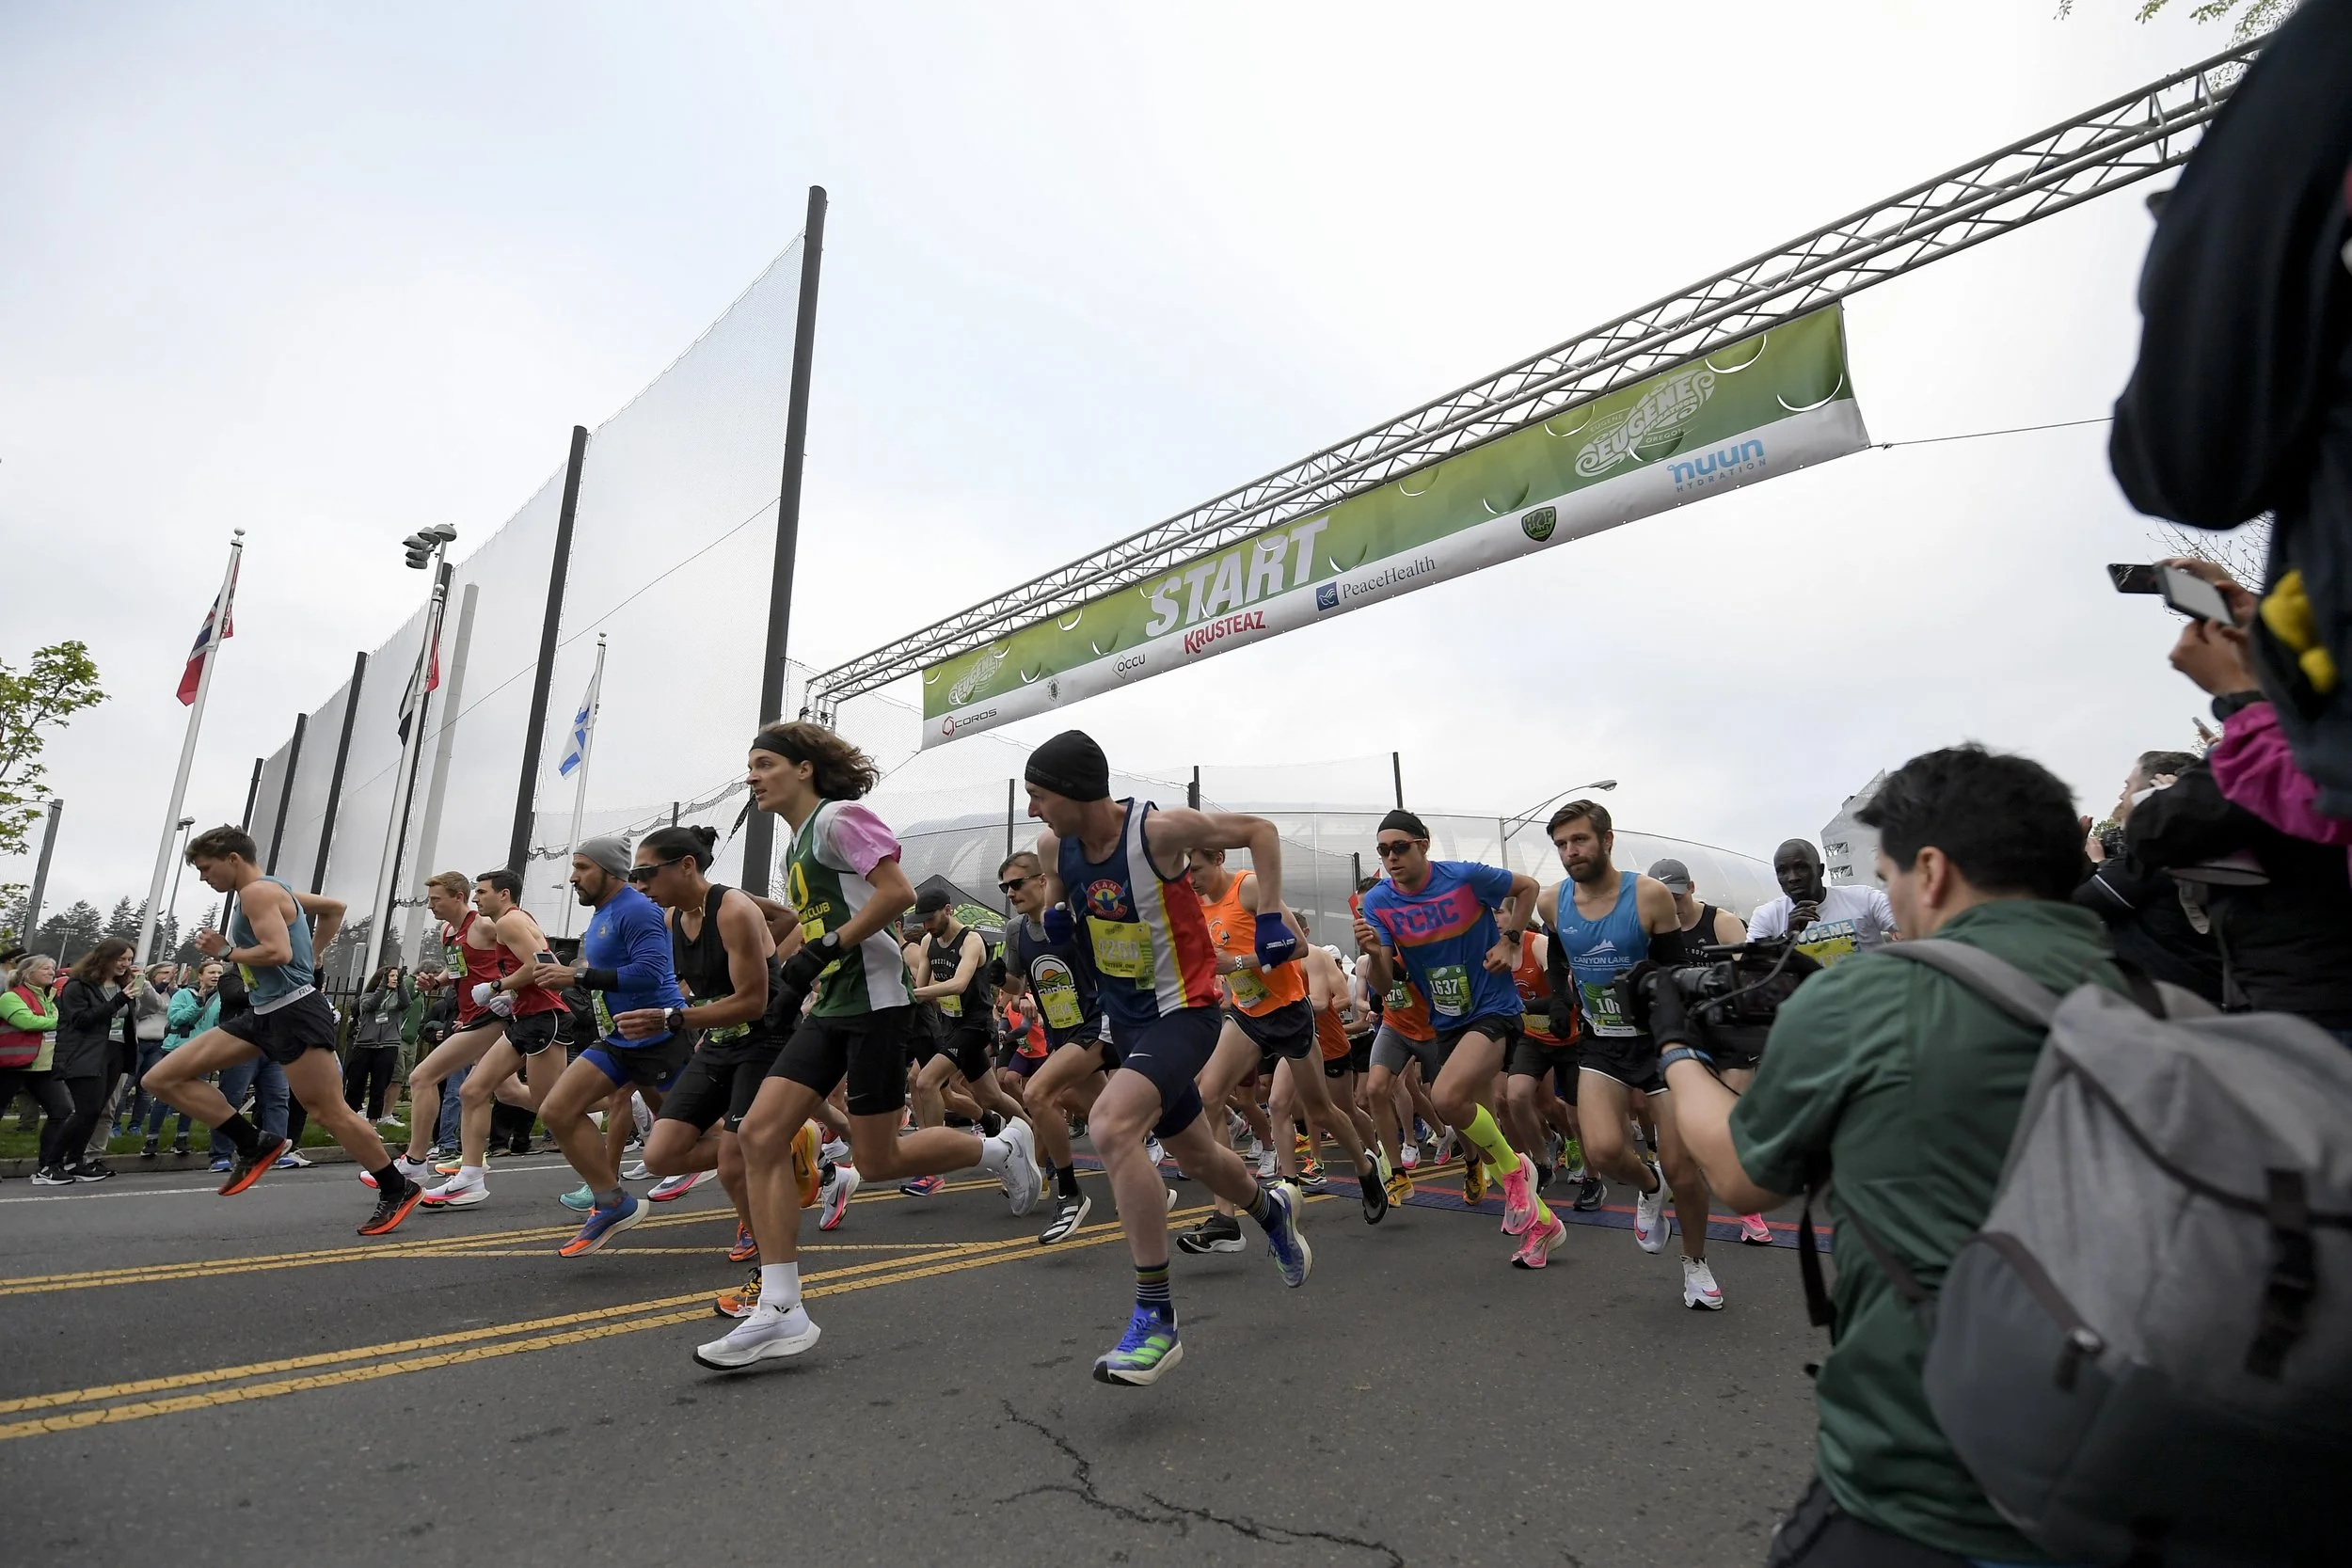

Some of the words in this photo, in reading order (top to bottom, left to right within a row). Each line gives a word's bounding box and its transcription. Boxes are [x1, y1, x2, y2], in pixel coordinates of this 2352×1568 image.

[1597, 377, 1697, 458] EUGENE
[1646, 427, 1686, 444] OREGON
[1668, 438, 1765, 484] nuun
[1677, 458, 1767, 493] HYDRATION
[1145, 515, 1329, 638] START
[1343, 556, 1437, 599] PeaceHealth
[1184, 610, 1266, 655] KRUSTEAZ
[1117, 654, 1146, 673] OCCU
[955, 708, 997, 728] COROS
[1091, 881, 1117, 893] TEAM
[807, 901, 831, 918] CLUB
[1390, 897, 1459, 936] FCRC
[1797, 921, 1854, 942] UGENE
[1573, 956, 1607, 965] CANYON
[1608, 956, 1630, 964] LAKE
[1429, 979, 1458, 995] 1637
